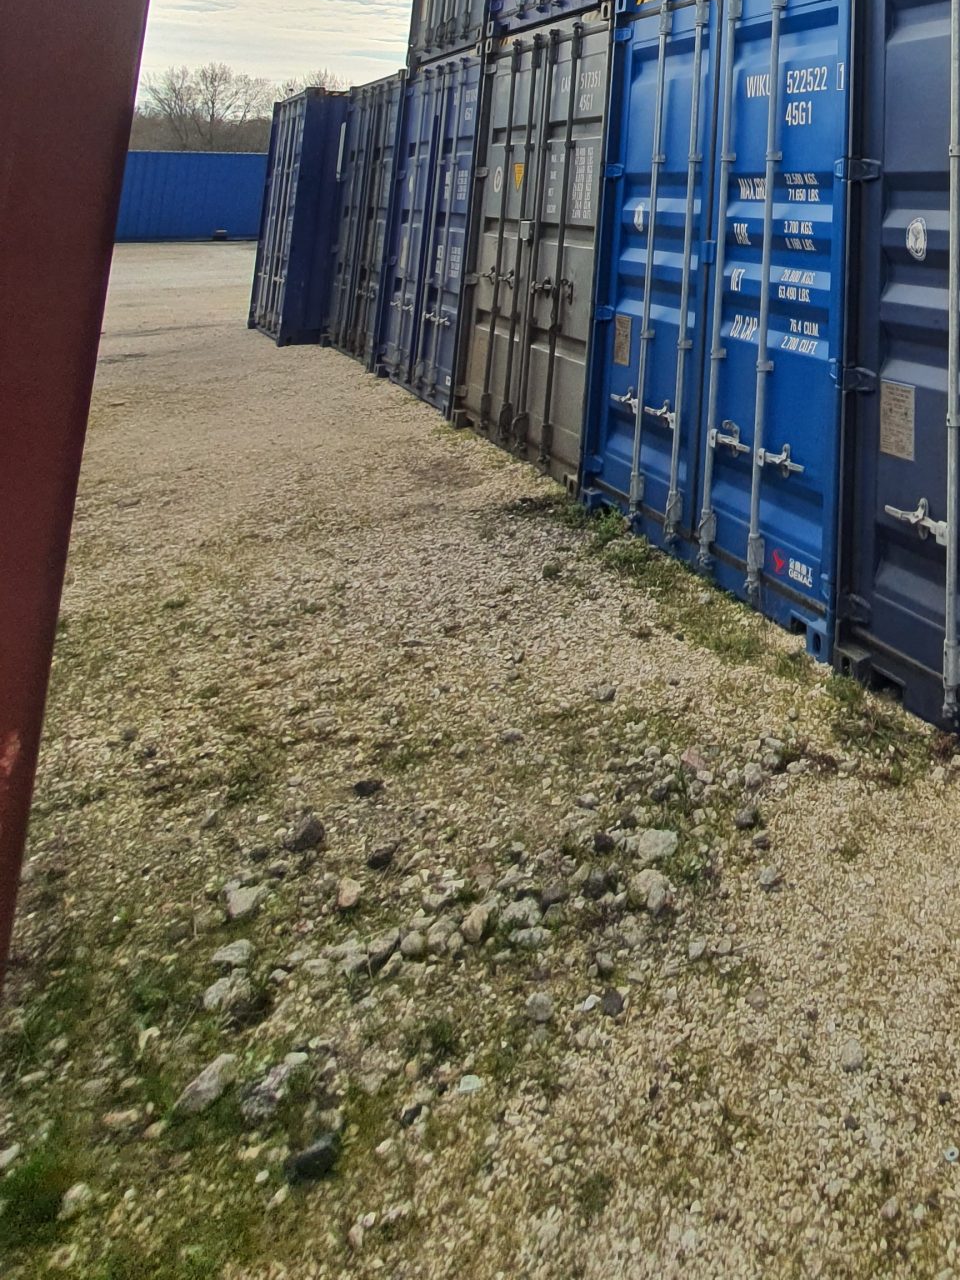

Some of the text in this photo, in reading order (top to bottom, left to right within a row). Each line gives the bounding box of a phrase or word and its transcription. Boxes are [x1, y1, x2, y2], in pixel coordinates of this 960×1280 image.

[746, 66, 828, 98] WIKU 522522
[785, 101, 813, 127] 45G1
[778, 285, 797, 300] 63.490
